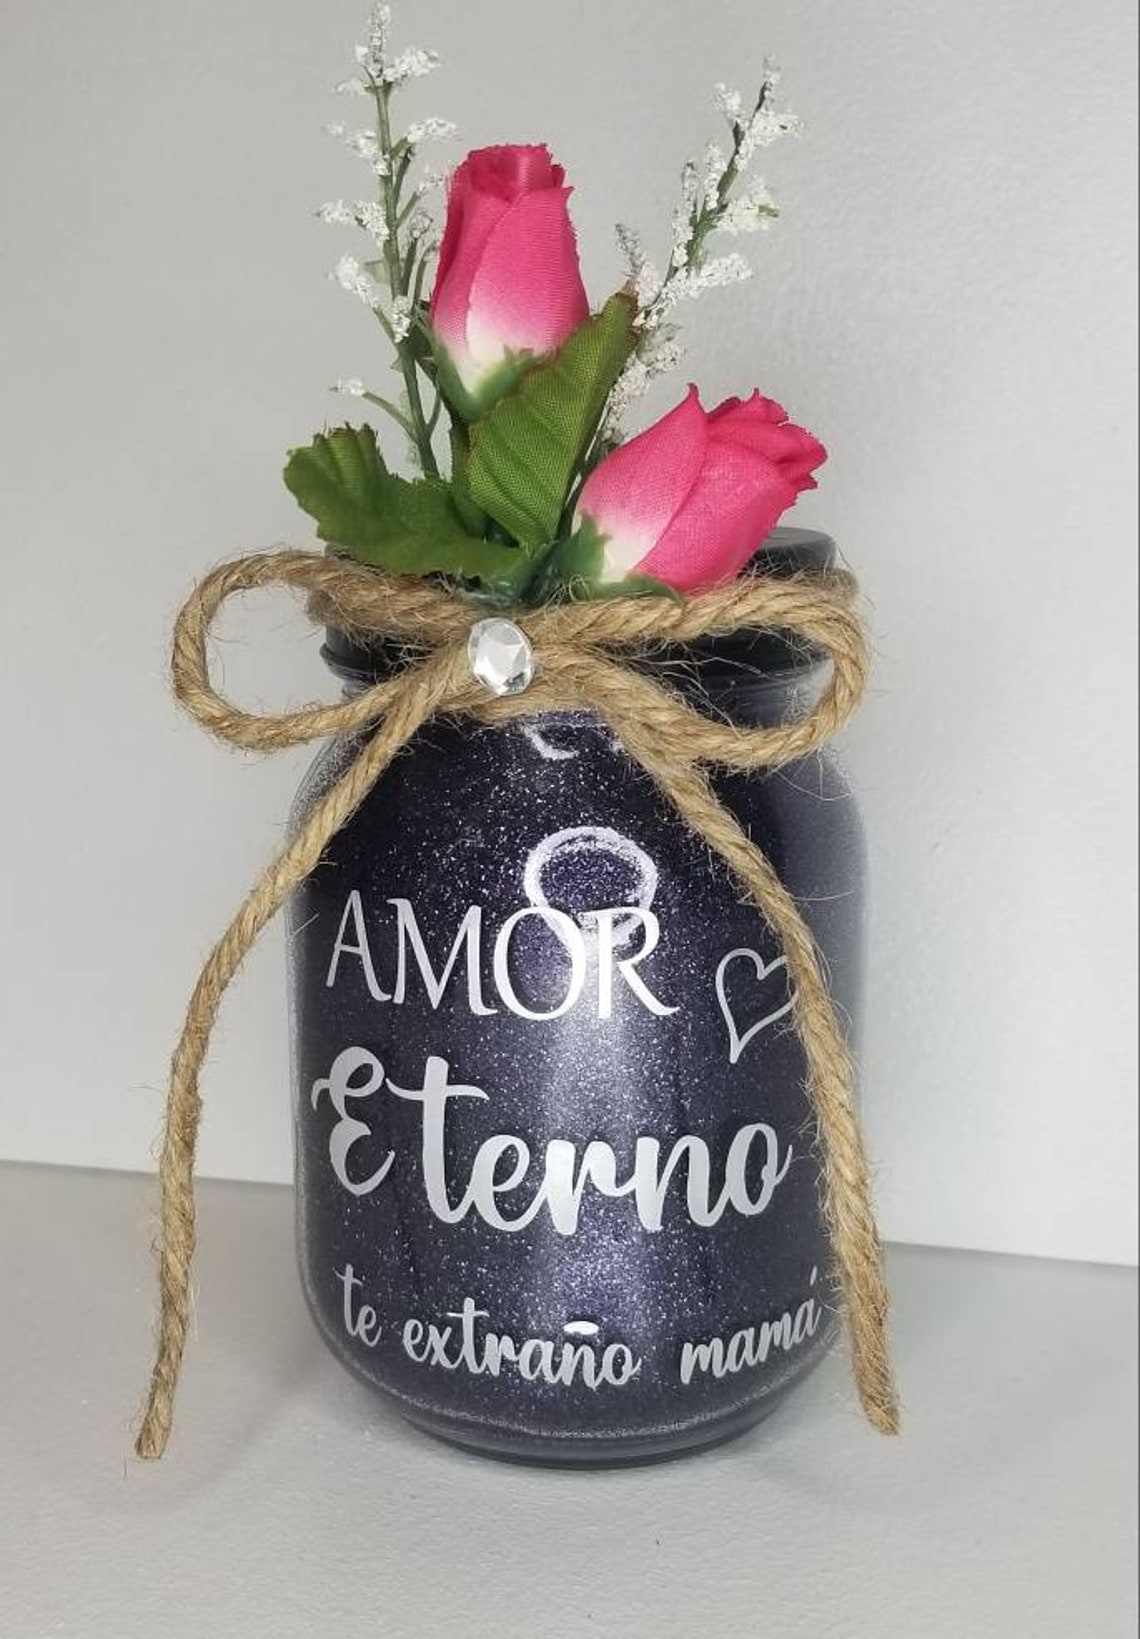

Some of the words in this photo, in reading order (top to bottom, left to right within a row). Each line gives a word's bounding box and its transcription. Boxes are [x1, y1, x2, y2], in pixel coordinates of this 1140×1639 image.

[327, 889, 680, 1021] AMOR
[311, 1046, 792, 1236] Eterno
[335, 1262, 382, 1348] te
[402, 1297, 641, 1387] extraño
[679, 1264, 822, 1385] mamá
